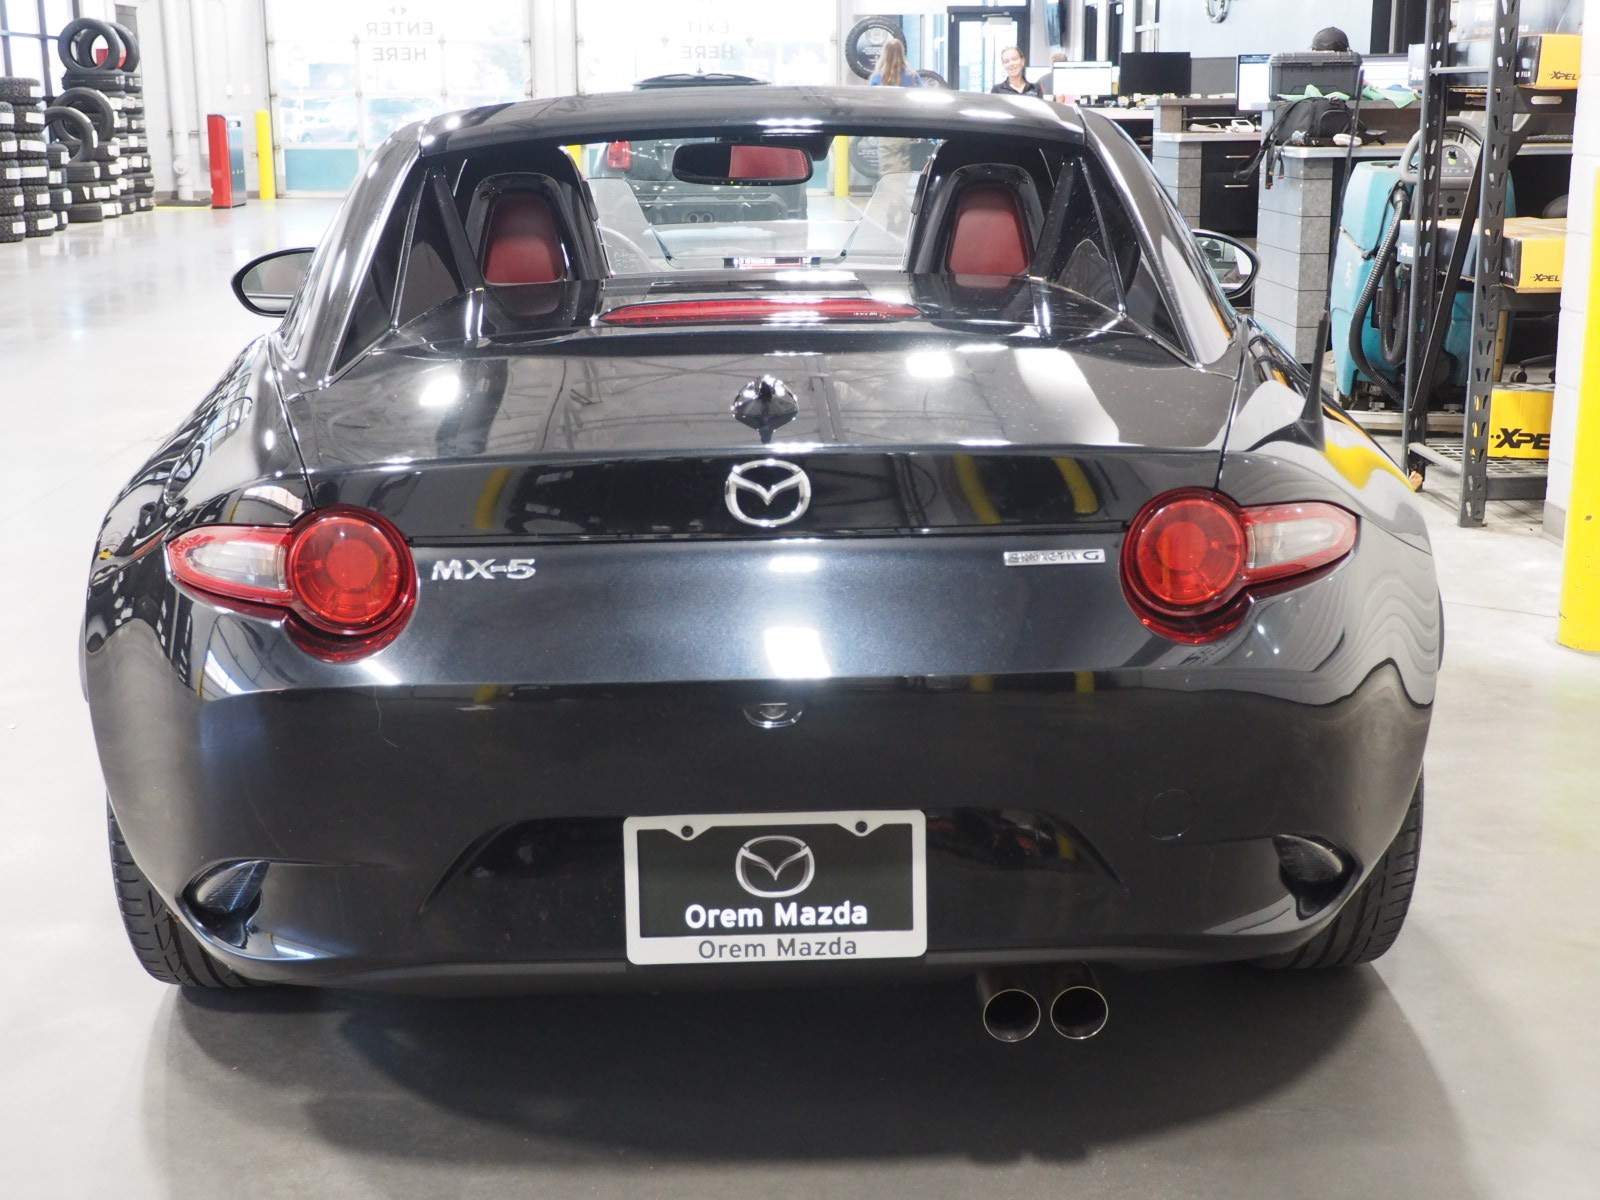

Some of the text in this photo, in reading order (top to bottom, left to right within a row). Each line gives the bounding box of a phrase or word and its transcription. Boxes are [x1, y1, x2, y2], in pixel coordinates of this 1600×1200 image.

[1550, 71, 1577, 80] XPEL
[1533, 273, 1560, 282] XPEL
[1493, 428, 1550, 450] XPE
[431, 559, 536, 580] MX-5
[685, 901, 868, 929] Orem Mazda
[698, 937, 857, 959] Orem Mazda
